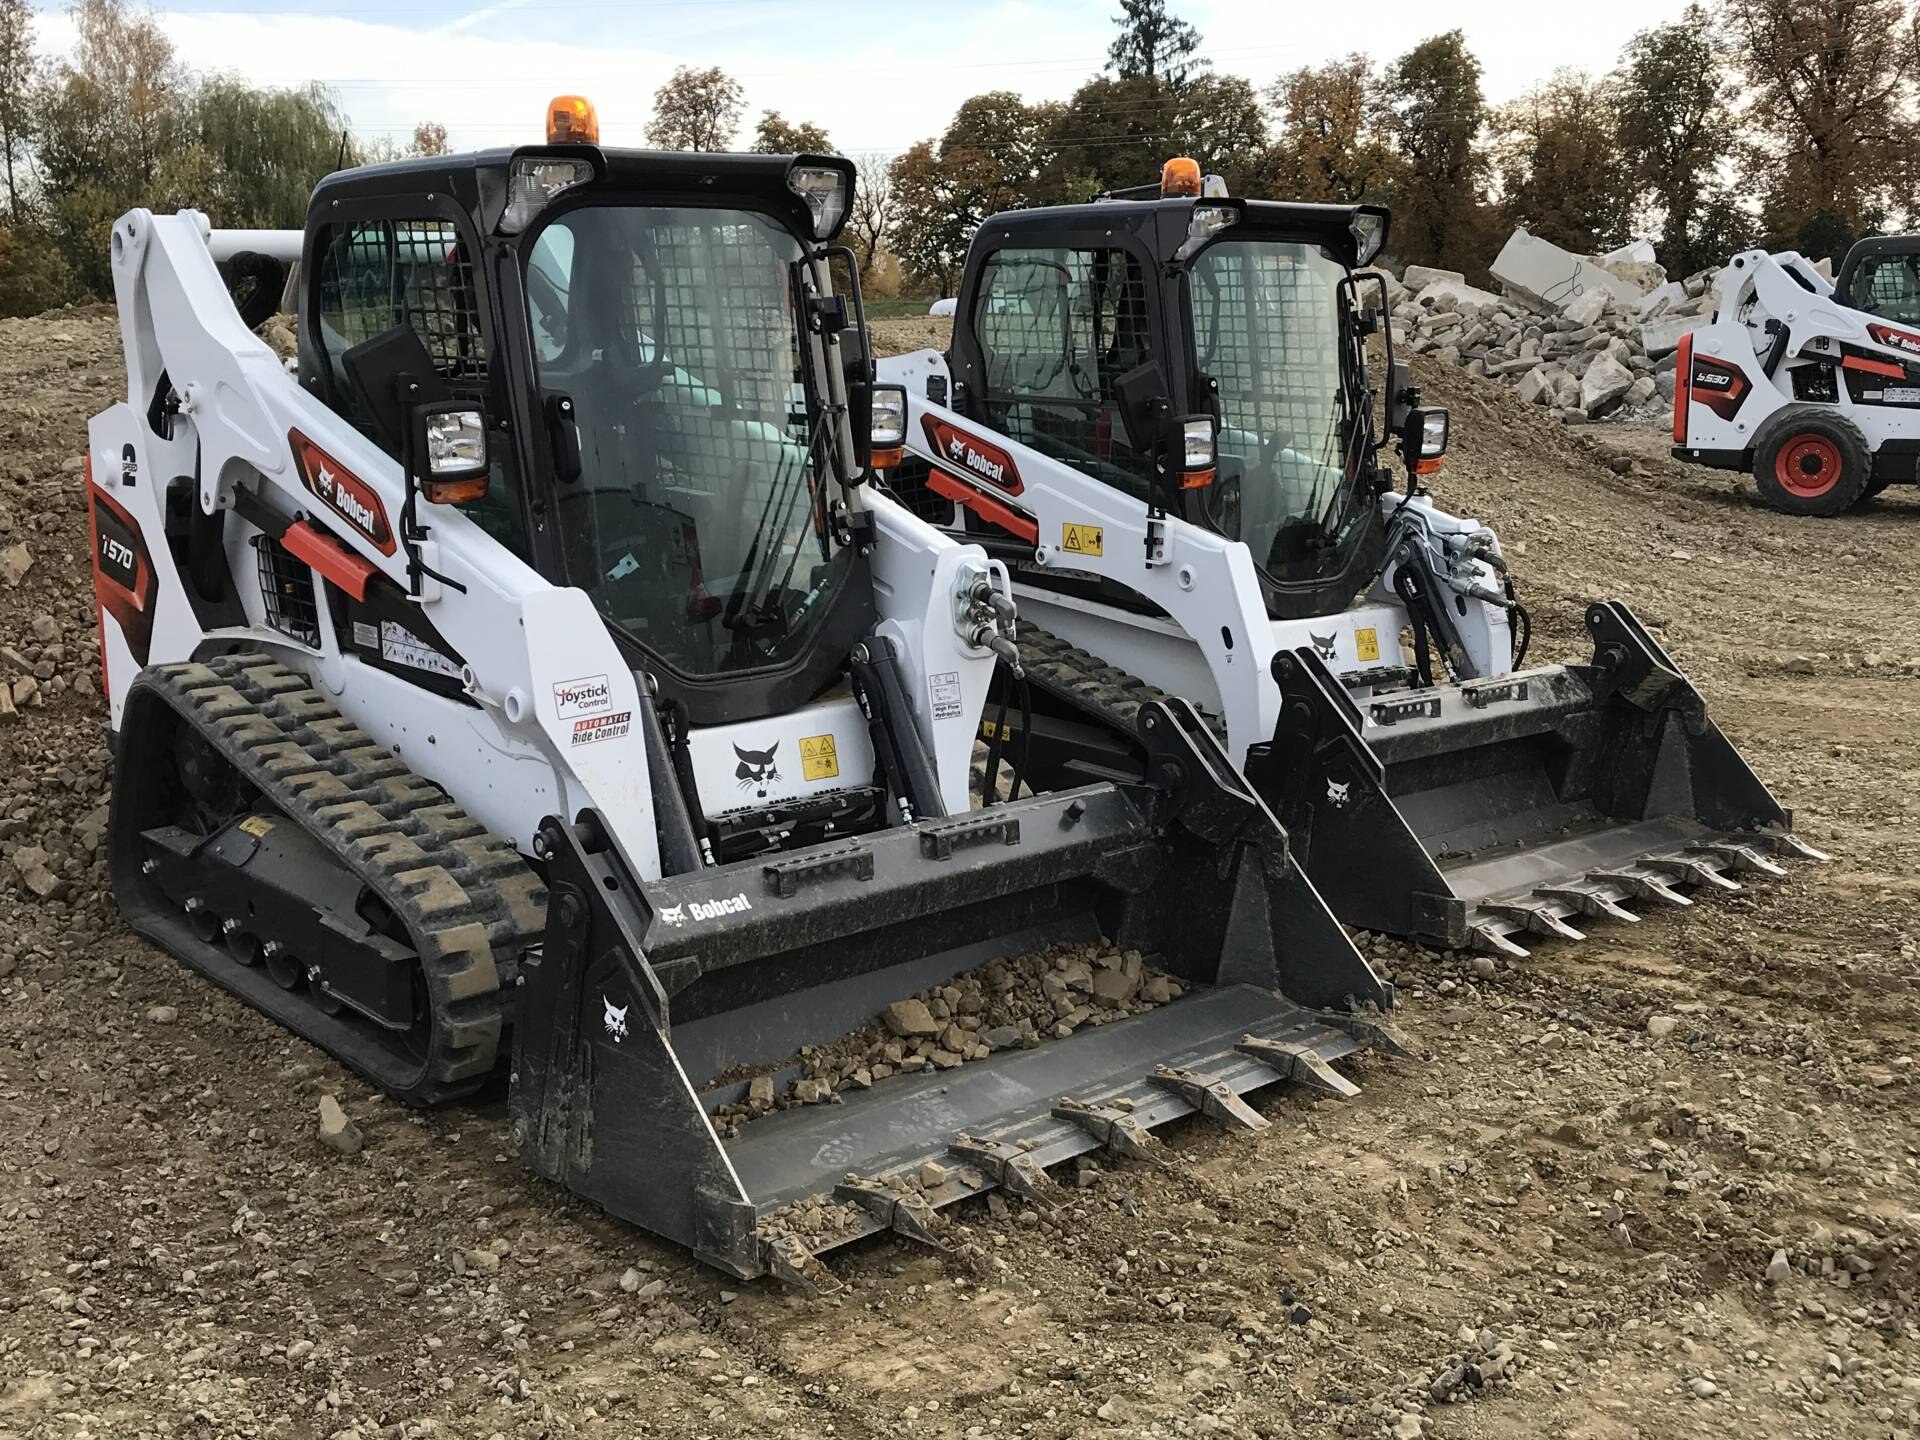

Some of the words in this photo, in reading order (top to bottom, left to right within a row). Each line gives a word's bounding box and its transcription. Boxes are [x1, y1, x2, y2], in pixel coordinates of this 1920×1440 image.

[966, 447, 1004, 482] Bobcat
[336, 482, 375, 534] Bobcat
[578, 696, 609, 709] Control
[571, 730, 593, 745] Ride
[594, 722, 630, 740] Control
[574, 712, 631, 731] AUTOMATIC
[688, 892, 752, 921] Bobcat
